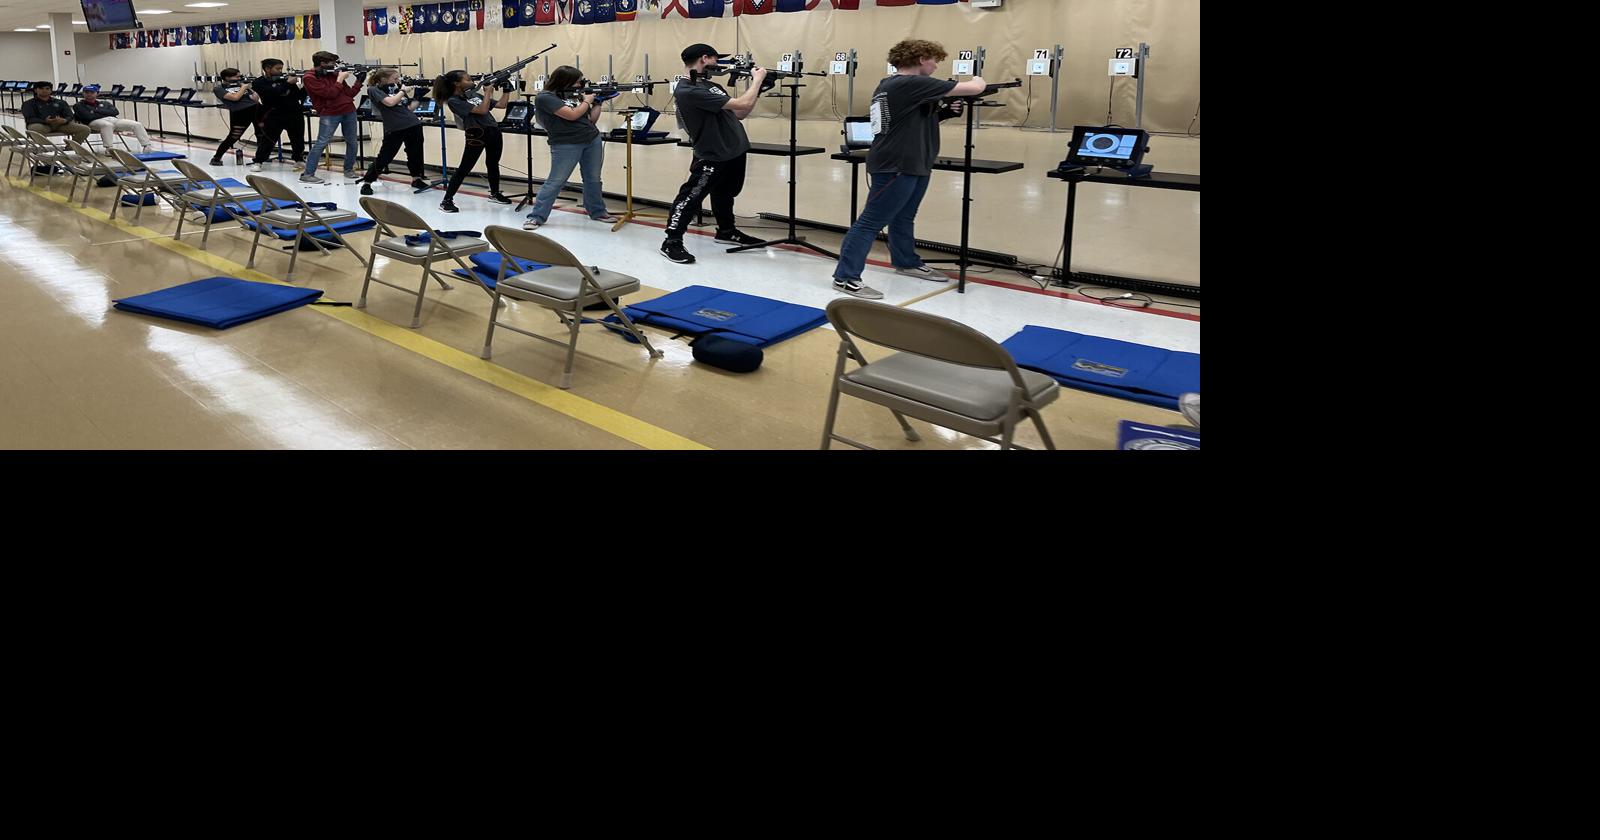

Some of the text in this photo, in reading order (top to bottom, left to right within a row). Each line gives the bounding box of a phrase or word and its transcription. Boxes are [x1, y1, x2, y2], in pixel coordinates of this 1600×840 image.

[783, 54, 792, 62] 67
[836, 53, 846, 61] 68
[960, 51, 972, 60] 70
[1036, 50, 1048, 59] 71
[1117, 49, 1131, 58] 72
